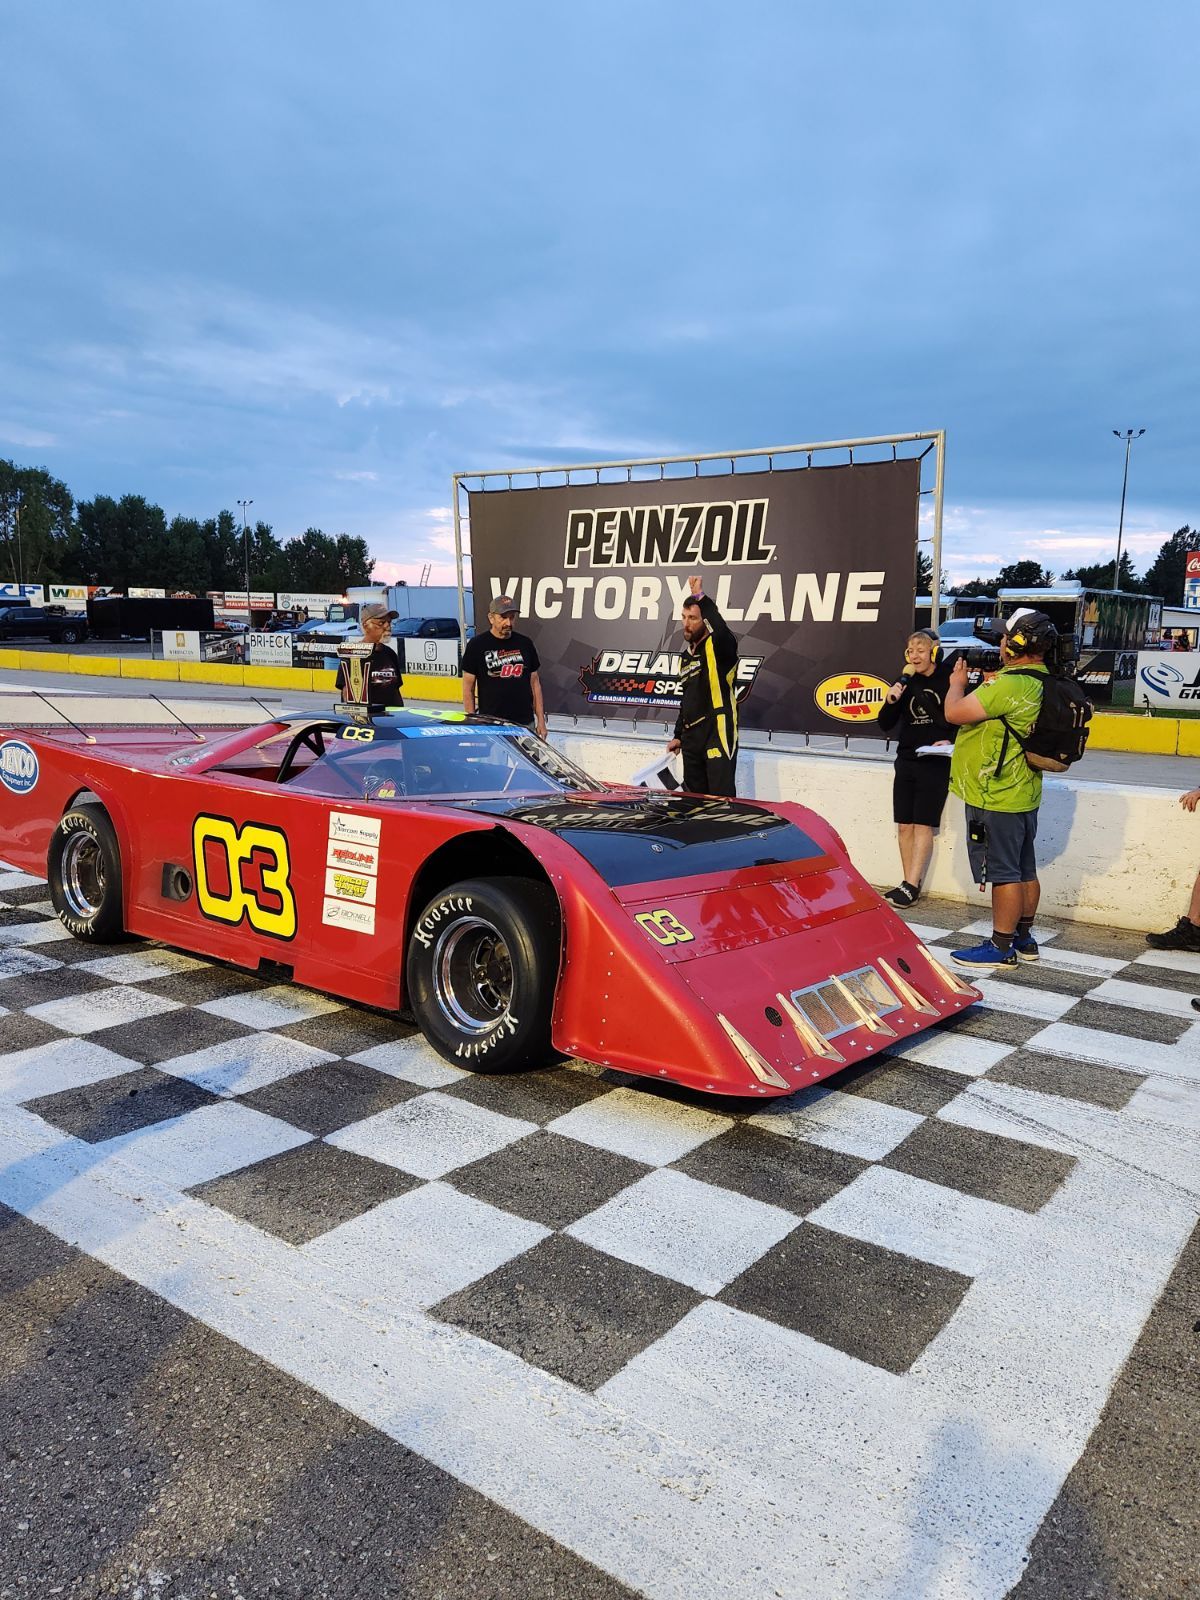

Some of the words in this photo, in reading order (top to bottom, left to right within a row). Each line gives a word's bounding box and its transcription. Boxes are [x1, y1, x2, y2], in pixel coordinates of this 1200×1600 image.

[564, 498, 776, 568] PENNZOIL
[52, 588, 85, 598] WM
[490, 577, 690, 620] VICTORY
[715, 572, 886, 622] LANE
[250, 634, 291, 648] BRI-ECK
[407, 662, 458, 676] FIREFIELD
[598, 651, 761, 681] DELAE
[653, 679, 745, 700] SPEY
[826, 688, 883, 706] PENNZOIL
[598, 695, 626, 703] CANADIAN
[649, 698, 682, 706] LANDMARK
[342, 726, 375, 742] 03
[359, 829, 378, 840] Supply
[192, 811, 298, 942] 03
[414, 898, 473, 949] Hoosier
[634, 908, 696, 946] 03
[455, 1011, 519, 1059] Hoosier
